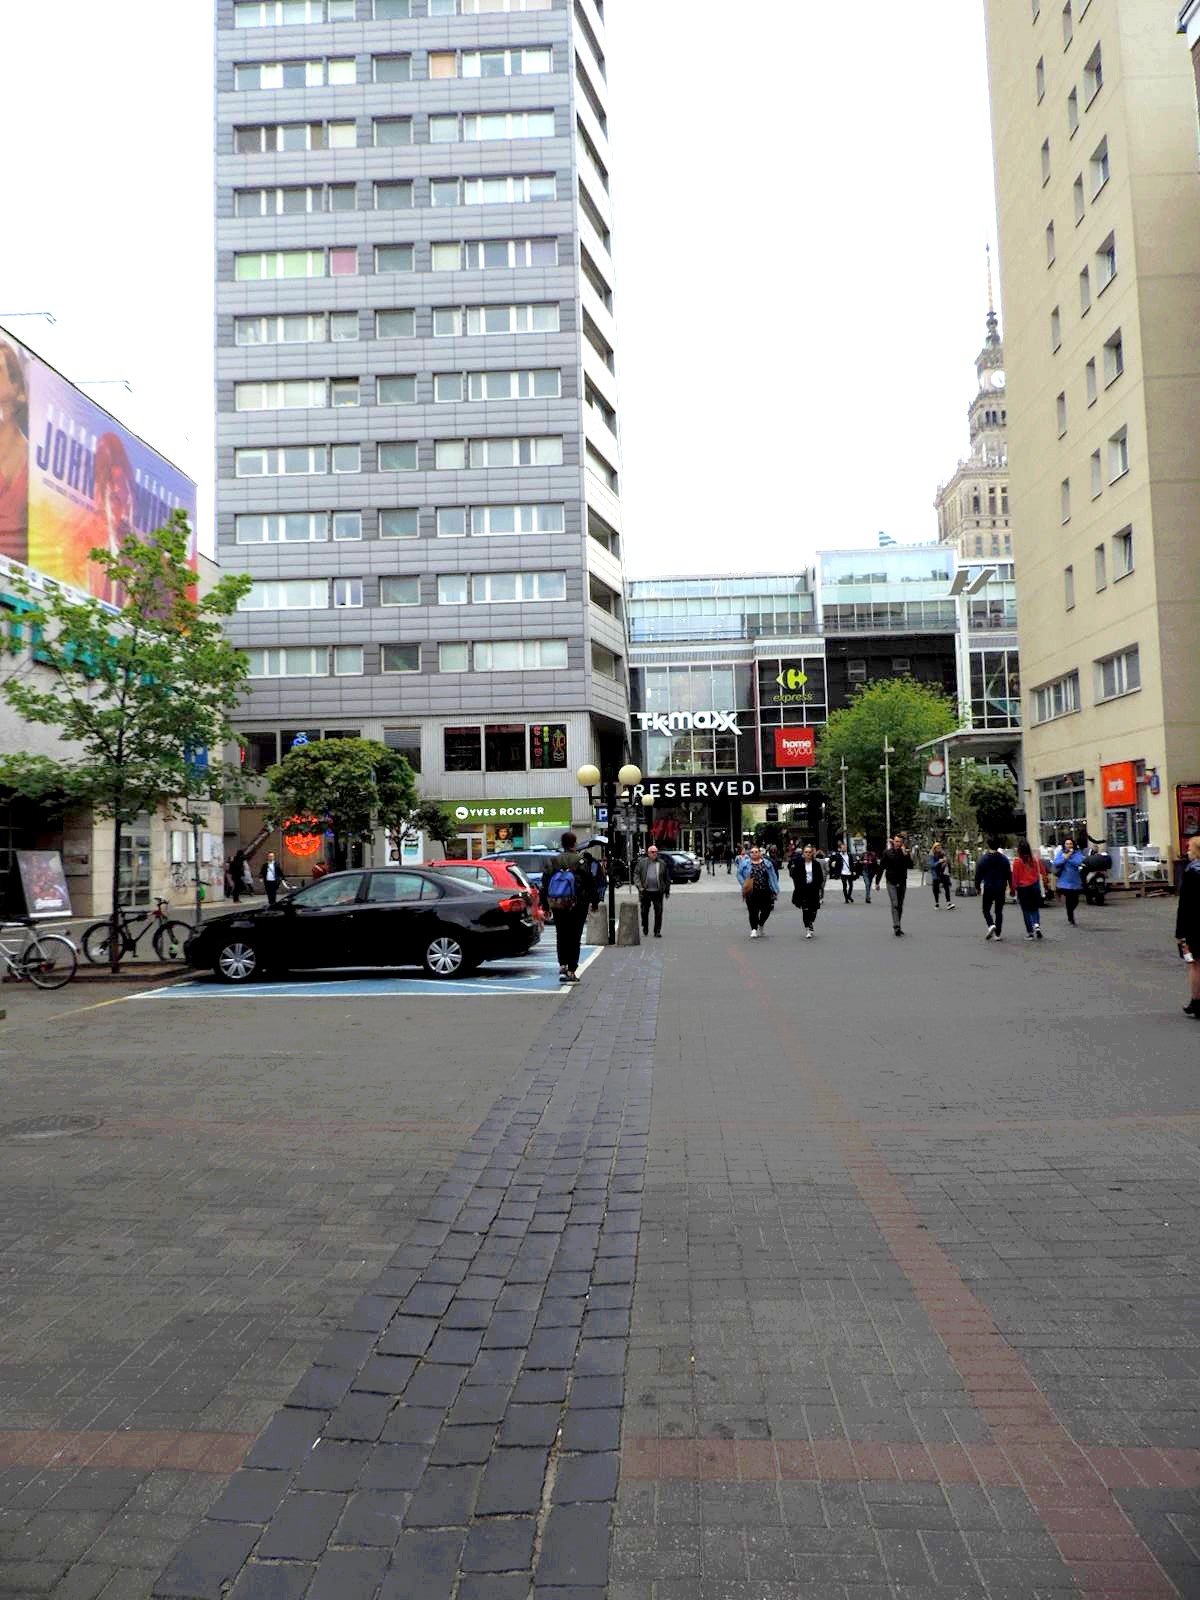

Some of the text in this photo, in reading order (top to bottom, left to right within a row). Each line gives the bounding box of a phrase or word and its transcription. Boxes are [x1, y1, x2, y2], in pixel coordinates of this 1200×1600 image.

[36, 421, 97, 500] JOHN
[773, 693, 813, 703] express
[782, 739, 812, 749] home
[633, 780, 755, 798] RESERVED
[470, 806, 545, 817] YVES ROCHER
